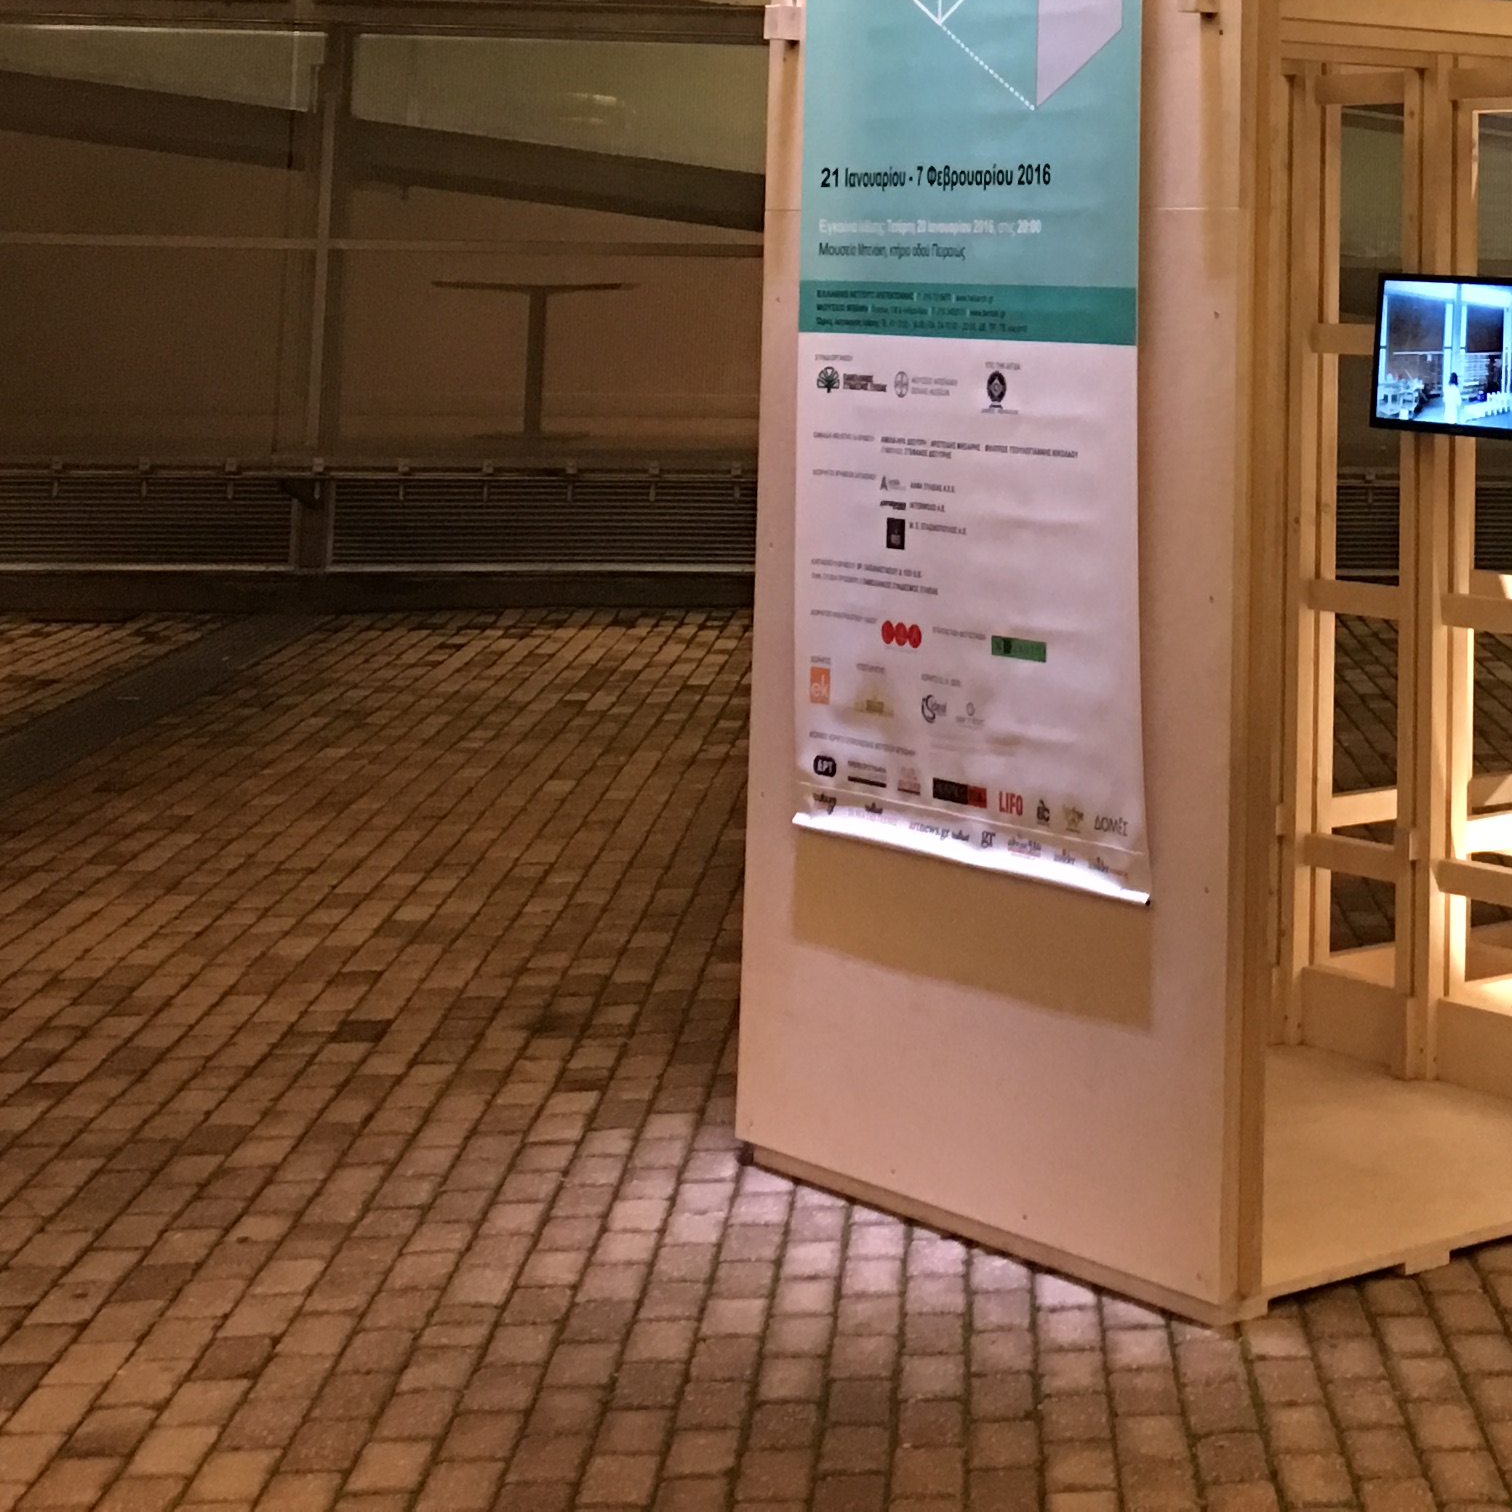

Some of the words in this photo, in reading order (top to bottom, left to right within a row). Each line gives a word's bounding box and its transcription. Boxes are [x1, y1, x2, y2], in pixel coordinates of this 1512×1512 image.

[821, 167, 839, 188] 21
[845, 166, 906, 192] Ιανουαρίου
[917, 165, 924, 187] 7
[927, 163, 1014, 191] Φεβρουαρίου
[1017, 163, 1051, 186] 2016
[999, 791, 1023, 816] LIFO
